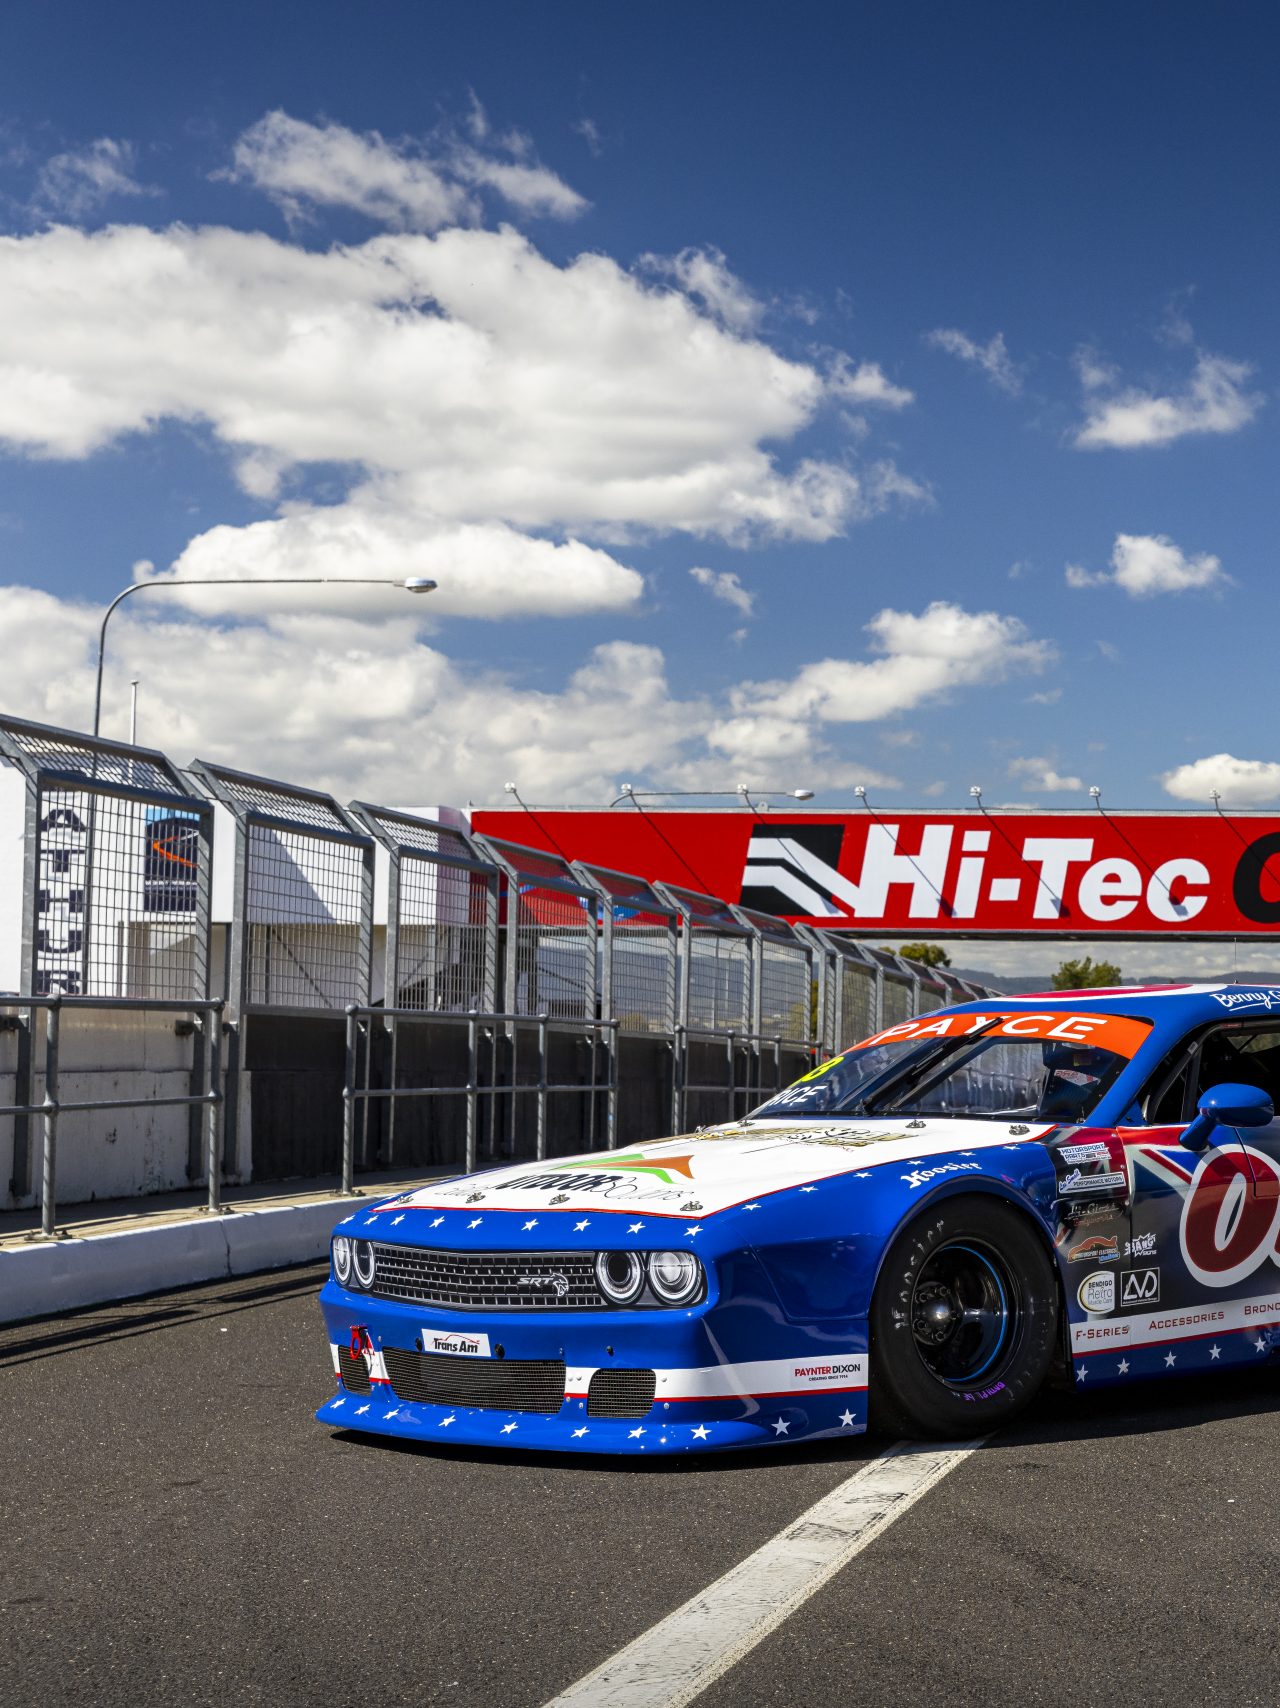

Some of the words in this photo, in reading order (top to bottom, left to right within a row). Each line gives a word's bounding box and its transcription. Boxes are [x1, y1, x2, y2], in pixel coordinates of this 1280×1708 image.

[854, 823, 1212, 922] Hi-Tec
[869, 1015, 1108, 1046] PAYCE
[1061, 1144, 1105, 1154] MOTORSPORT
[900, 1161, 983, 1190] Hoosier
[1073, 1178, 1105, 1187] PERFORMANCE
[1104, 1176, 1123, 1184] MOTORS
[517, 1277, 555, 1288] SRT
[1088, 1280, 1113, 1289] BENDIGO
[1076, 1325, 1130, 1341] F-SERIES
[1149, 1310, 1225, 1331] ACCESSORIES
[433, 1337, 458, 1353] Trans
[459, 1342, 479, 1354] Am
[794, 1366, 832, 1377] PAYNTER
[832, 1364, 861, 1374] DIXON
